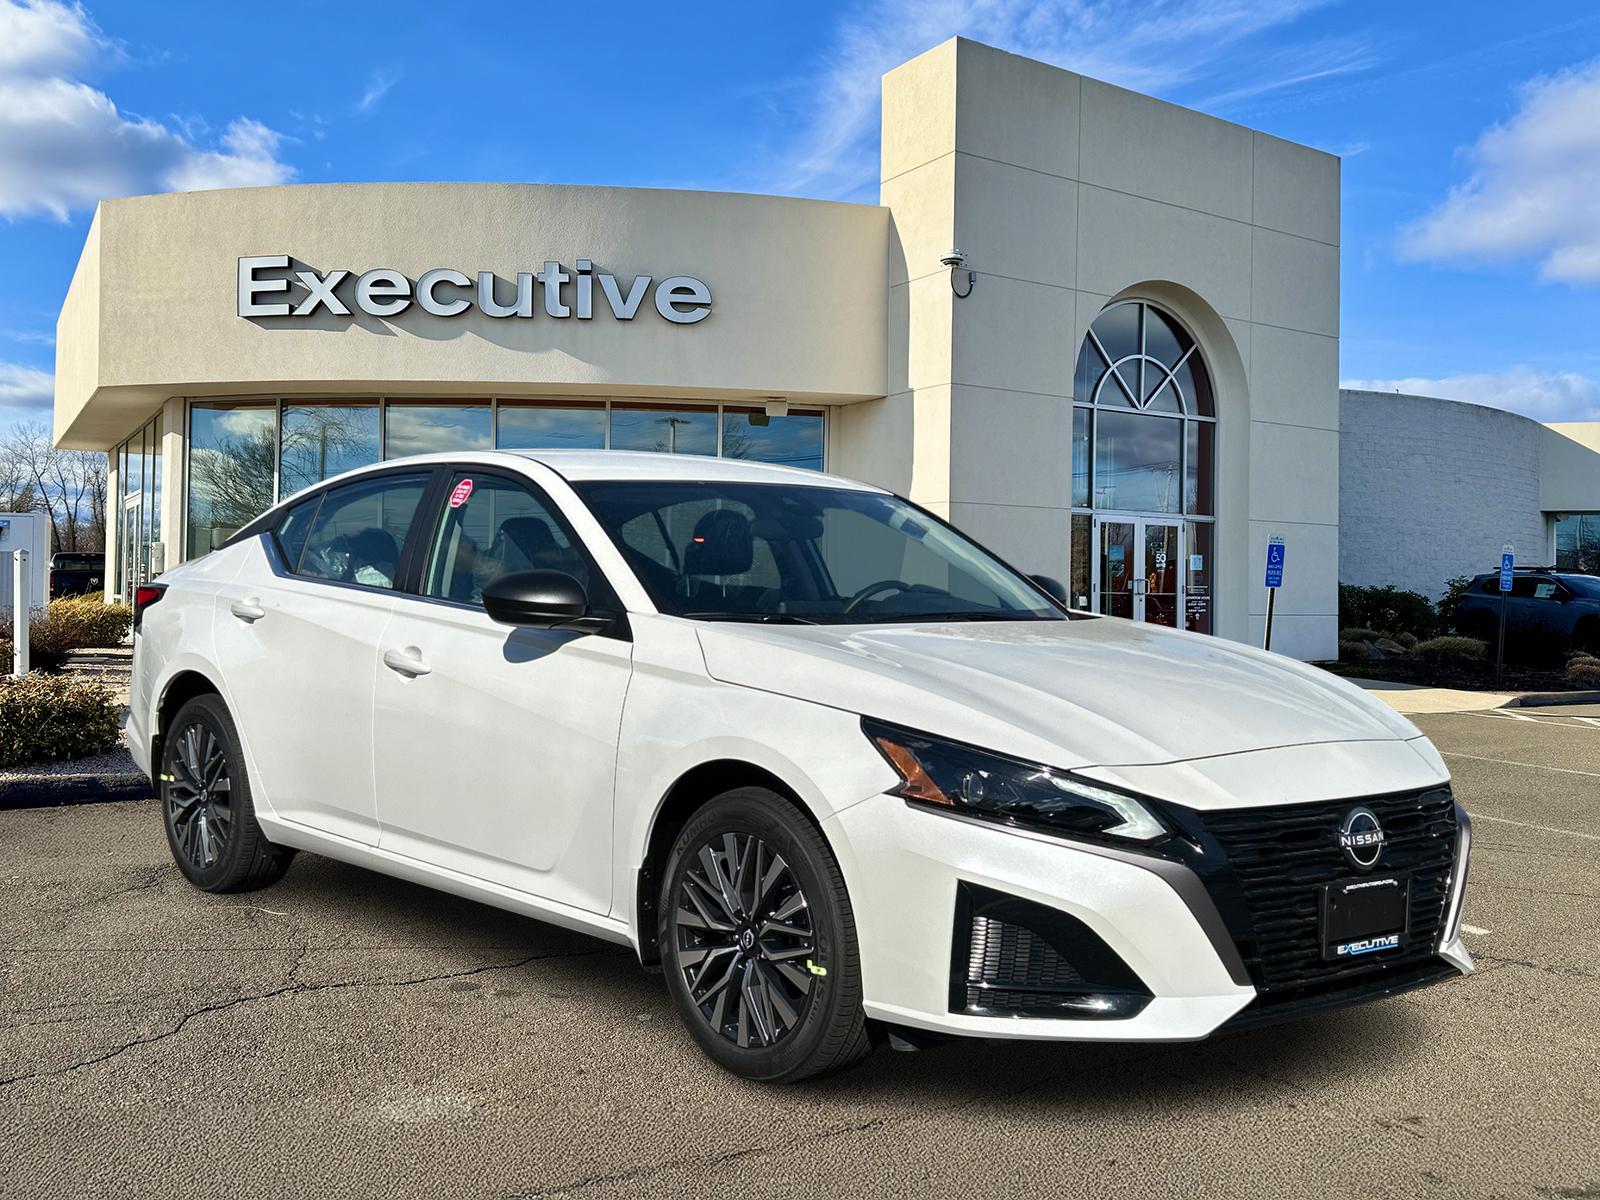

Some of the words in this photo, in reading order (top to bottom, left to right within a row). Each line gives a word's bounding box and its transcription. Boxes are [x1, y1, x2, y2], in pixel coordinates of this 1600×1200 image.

[237, 255, 713, 324] Executive
[1155, 553, 1167, 563] 50
[1341, 831, 1385, 847] NISSAN
[1337, 935, 1399, 955] EXECUTIVE
